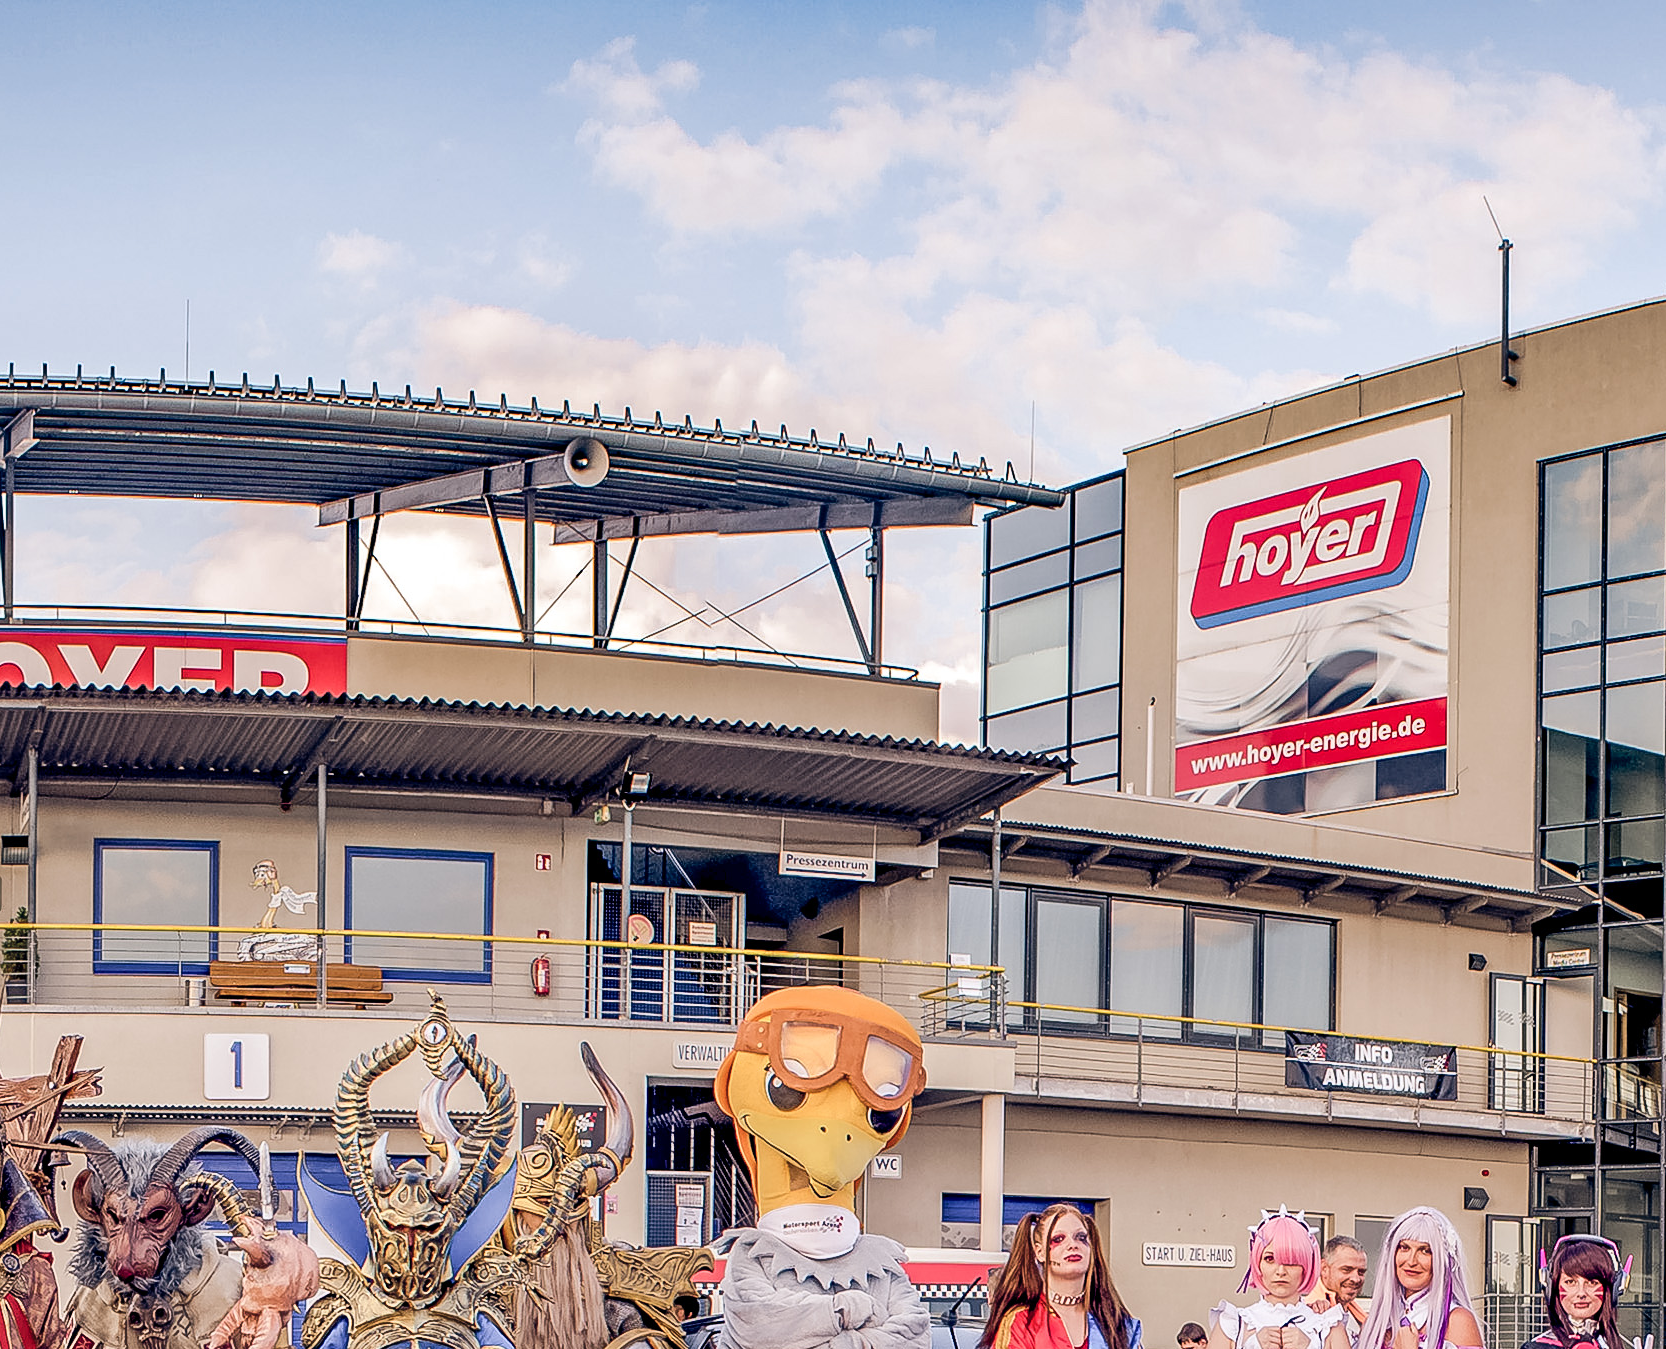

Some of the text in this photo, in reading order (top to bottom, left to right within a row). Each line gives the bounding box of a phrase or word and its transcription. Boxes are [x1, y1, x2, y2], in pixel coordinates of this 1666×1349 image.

[1220, 502, 1378, 588] hoyer
[1191, 715, 1426, 775] www.hoyer-energie.de
[786, 853, 870, 871] Pressezentrum
[678, 1044, 734, 1063] VERWALTU
[1355, 1043, 1393, 1064] INFO
[229, 1041, 242, 1088] 1
[1323, 1068, 1426, 1093] ANMELDUNG
[875, 1157, 898, 1171] WC
[1145, 1246, 1175, 1260] START
[1189, 1248, 1233, 1262] ZIEL-HAUS
